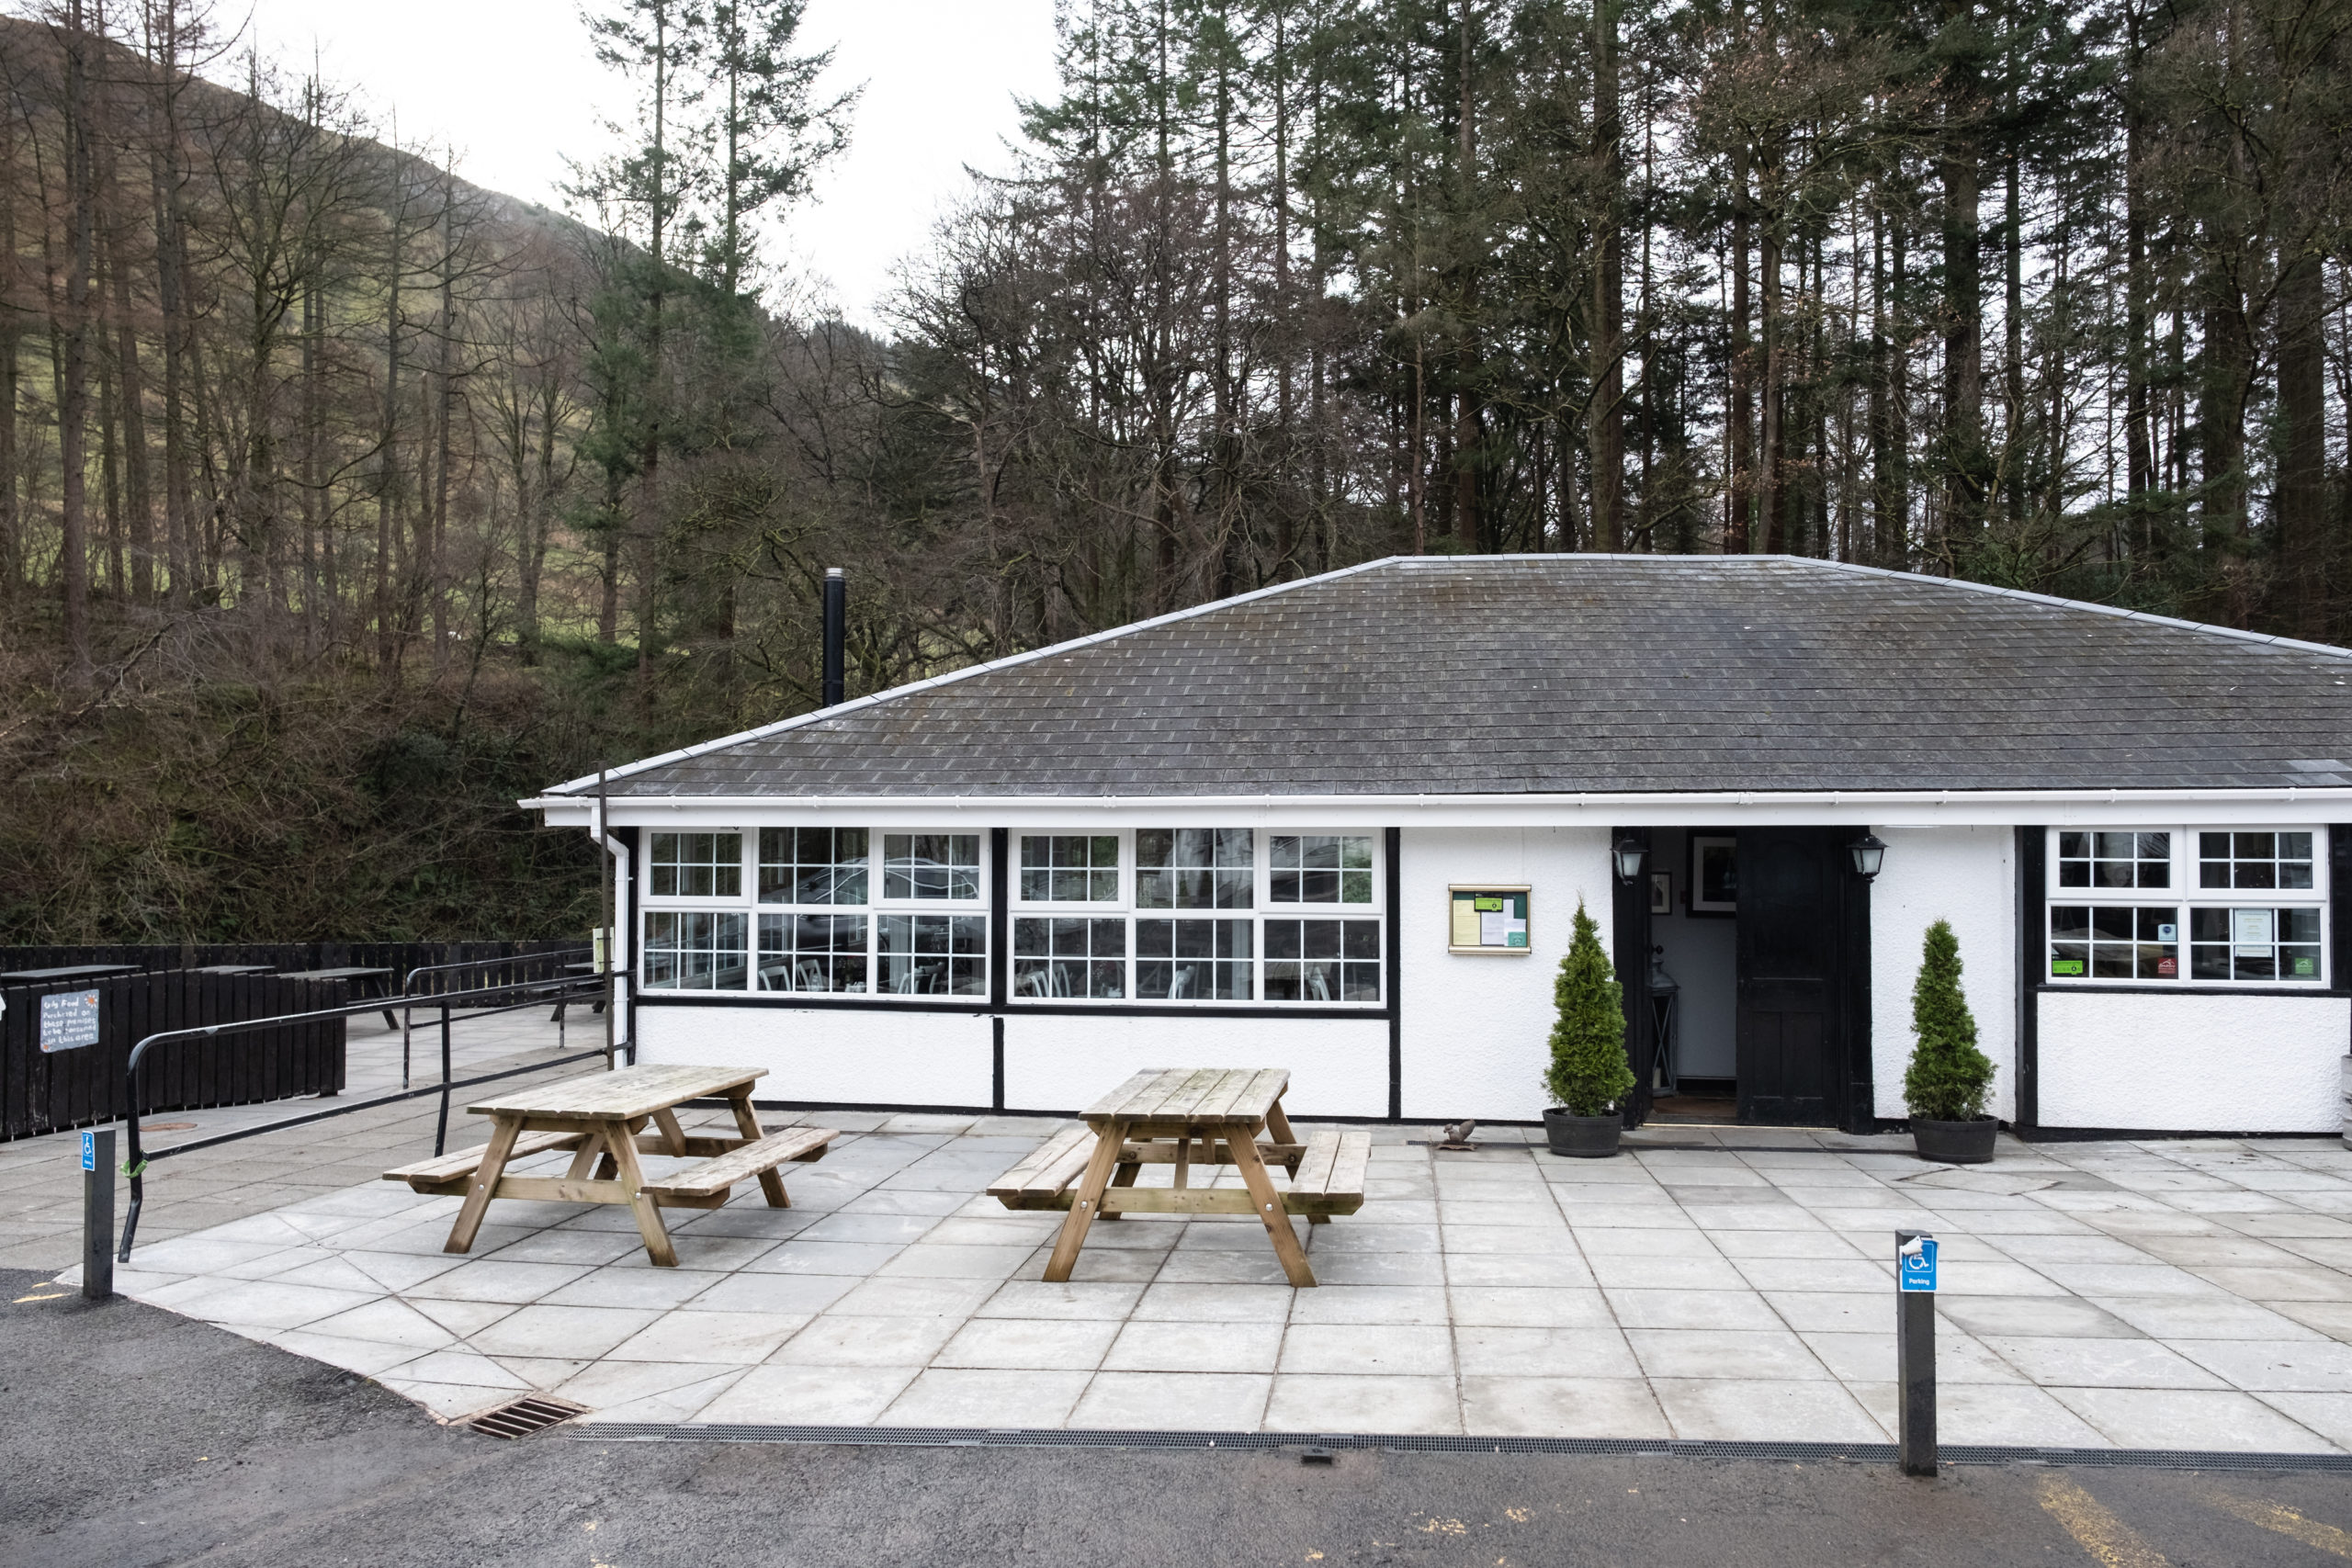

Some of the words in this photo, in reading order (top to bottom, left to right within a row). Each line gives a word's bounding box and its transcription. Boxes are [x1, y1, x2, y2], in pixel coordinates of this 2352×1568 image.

[61, 997, 79, 1007] Food
[58, 1035, 74, 1044] this
[1908, 1278, 1930, 1286] Parking
